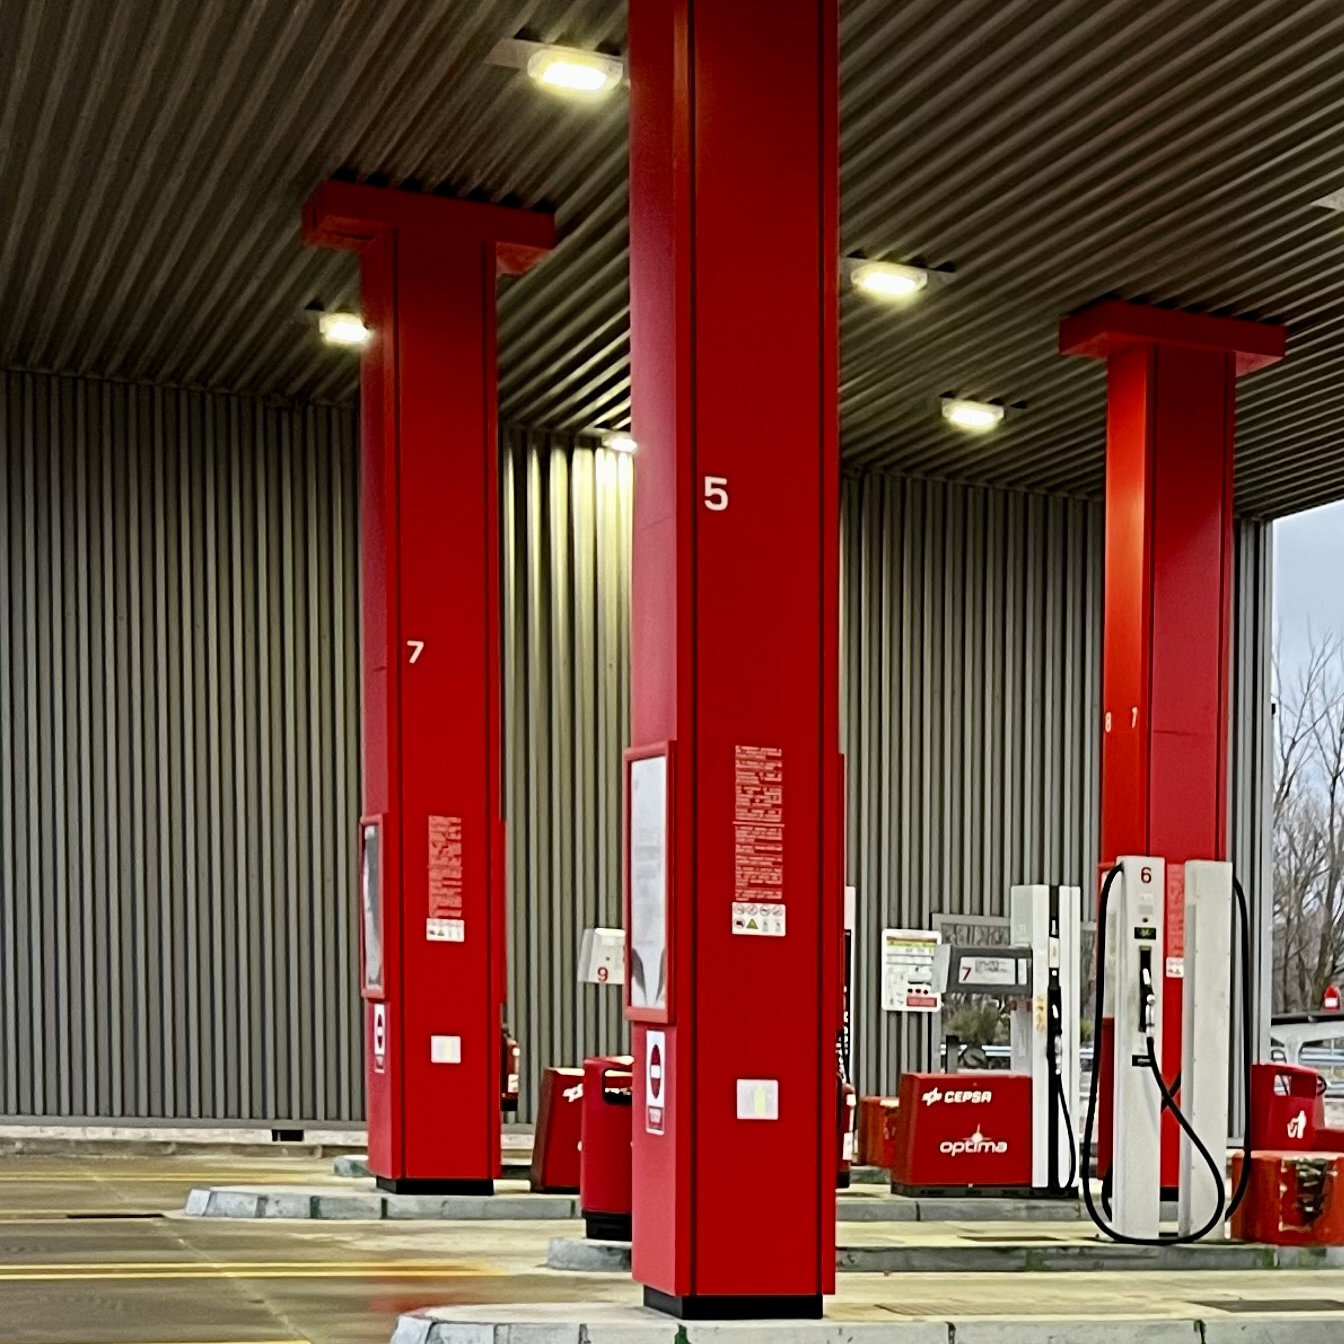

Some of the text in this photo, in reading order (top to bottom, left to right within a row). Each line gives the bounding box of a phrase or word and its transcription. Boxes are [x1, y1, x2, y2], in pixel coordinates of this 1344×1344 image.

[704, 476, 729, 511] 5
[407, 640, 424, 664] 7
[1141, 866, 1152, 884] 6
[597, 966, 608, 982] 9
[962, 967, 972, 981] 7
[944, 1091, 992, 1103] CEPSA
[939, 1136, 1008, 1157] optima
